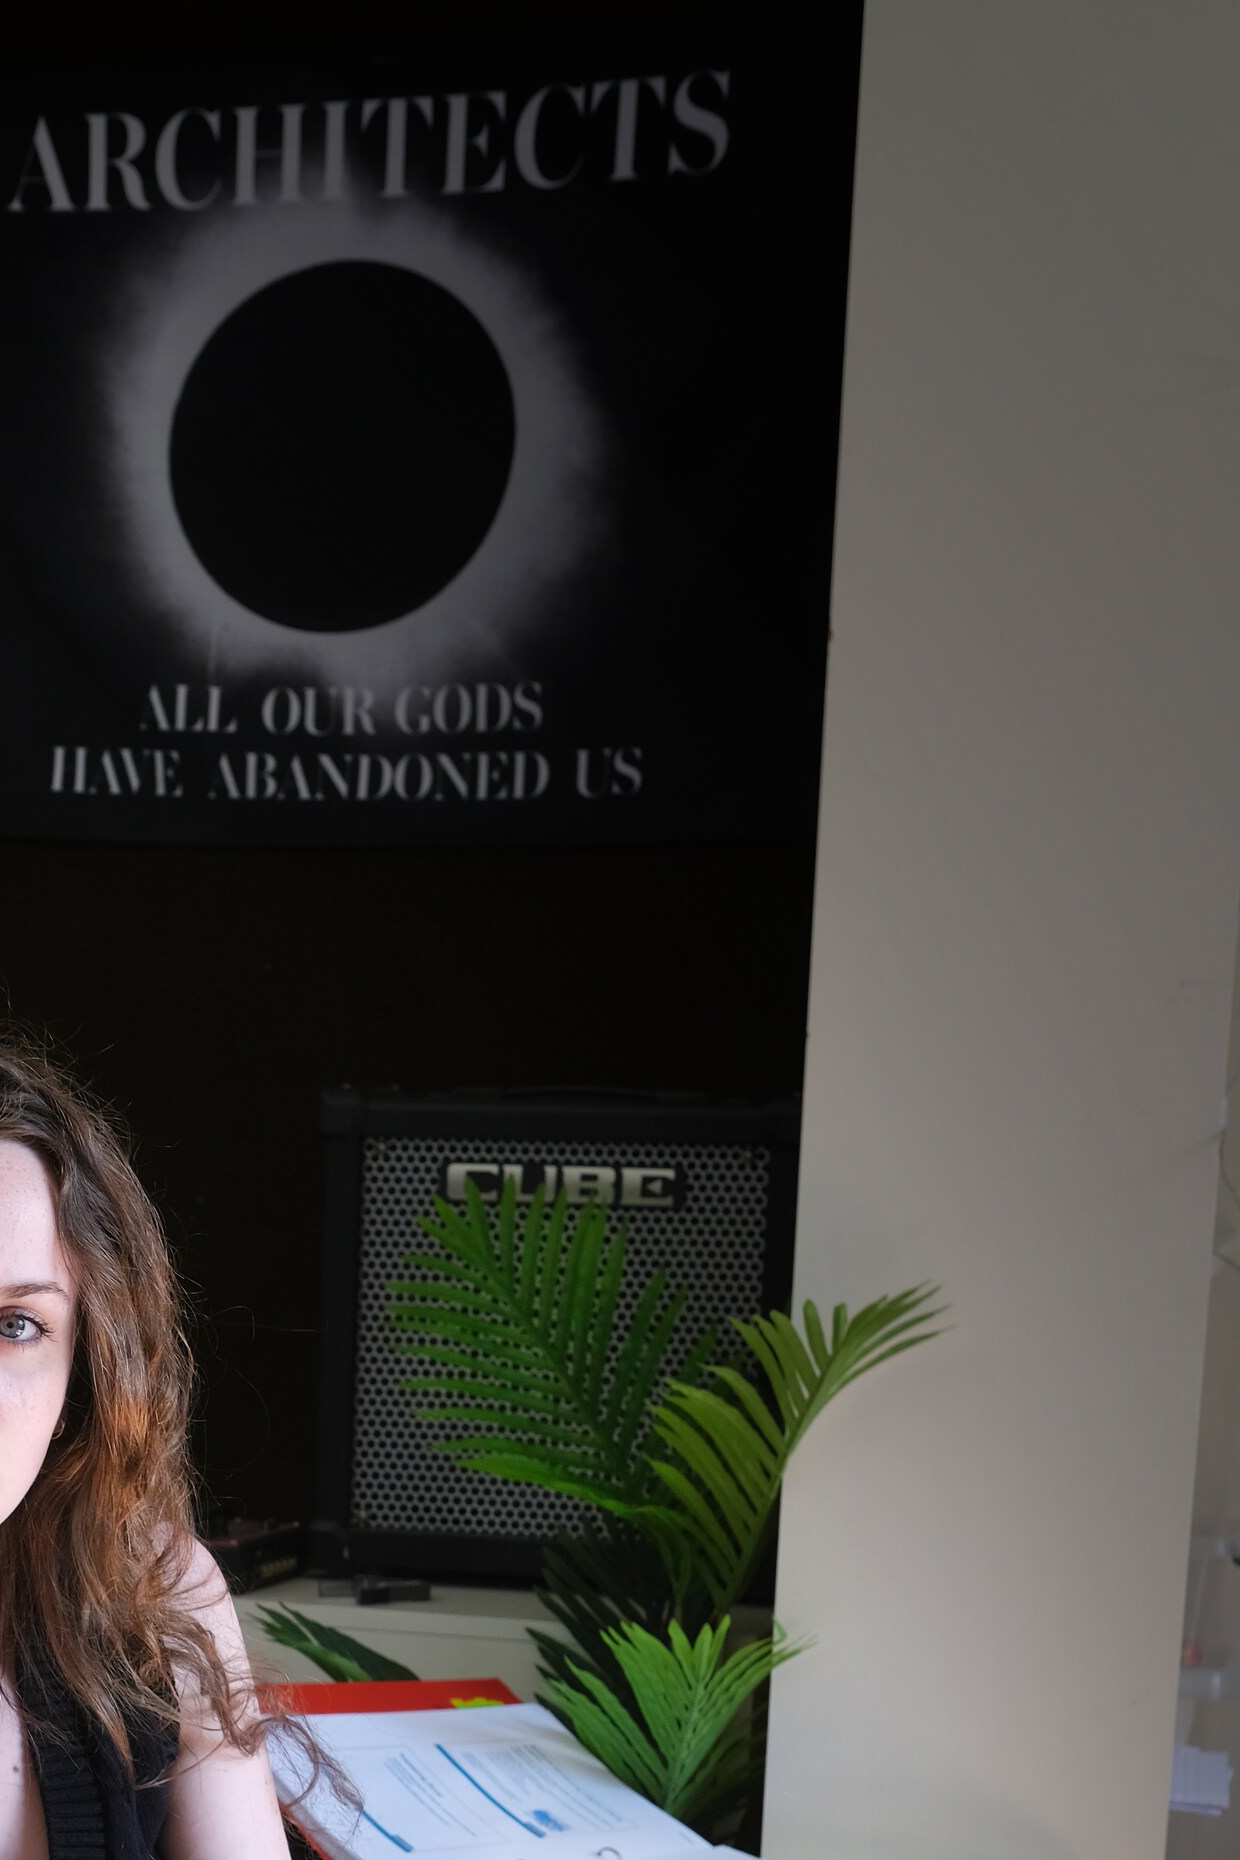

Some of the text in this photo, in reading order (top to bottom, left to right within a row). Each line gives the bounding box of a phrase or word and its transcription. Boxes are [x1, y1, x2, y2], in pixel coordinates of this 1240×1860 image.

[6, 67, 733, 213] ARCHITECTS
[139, 680, 544, 737] ALL OUR GODS
[49, 745, 644, 801] HAVE ABANDONED US
[446, 1162, 676, 1208] CUBE
